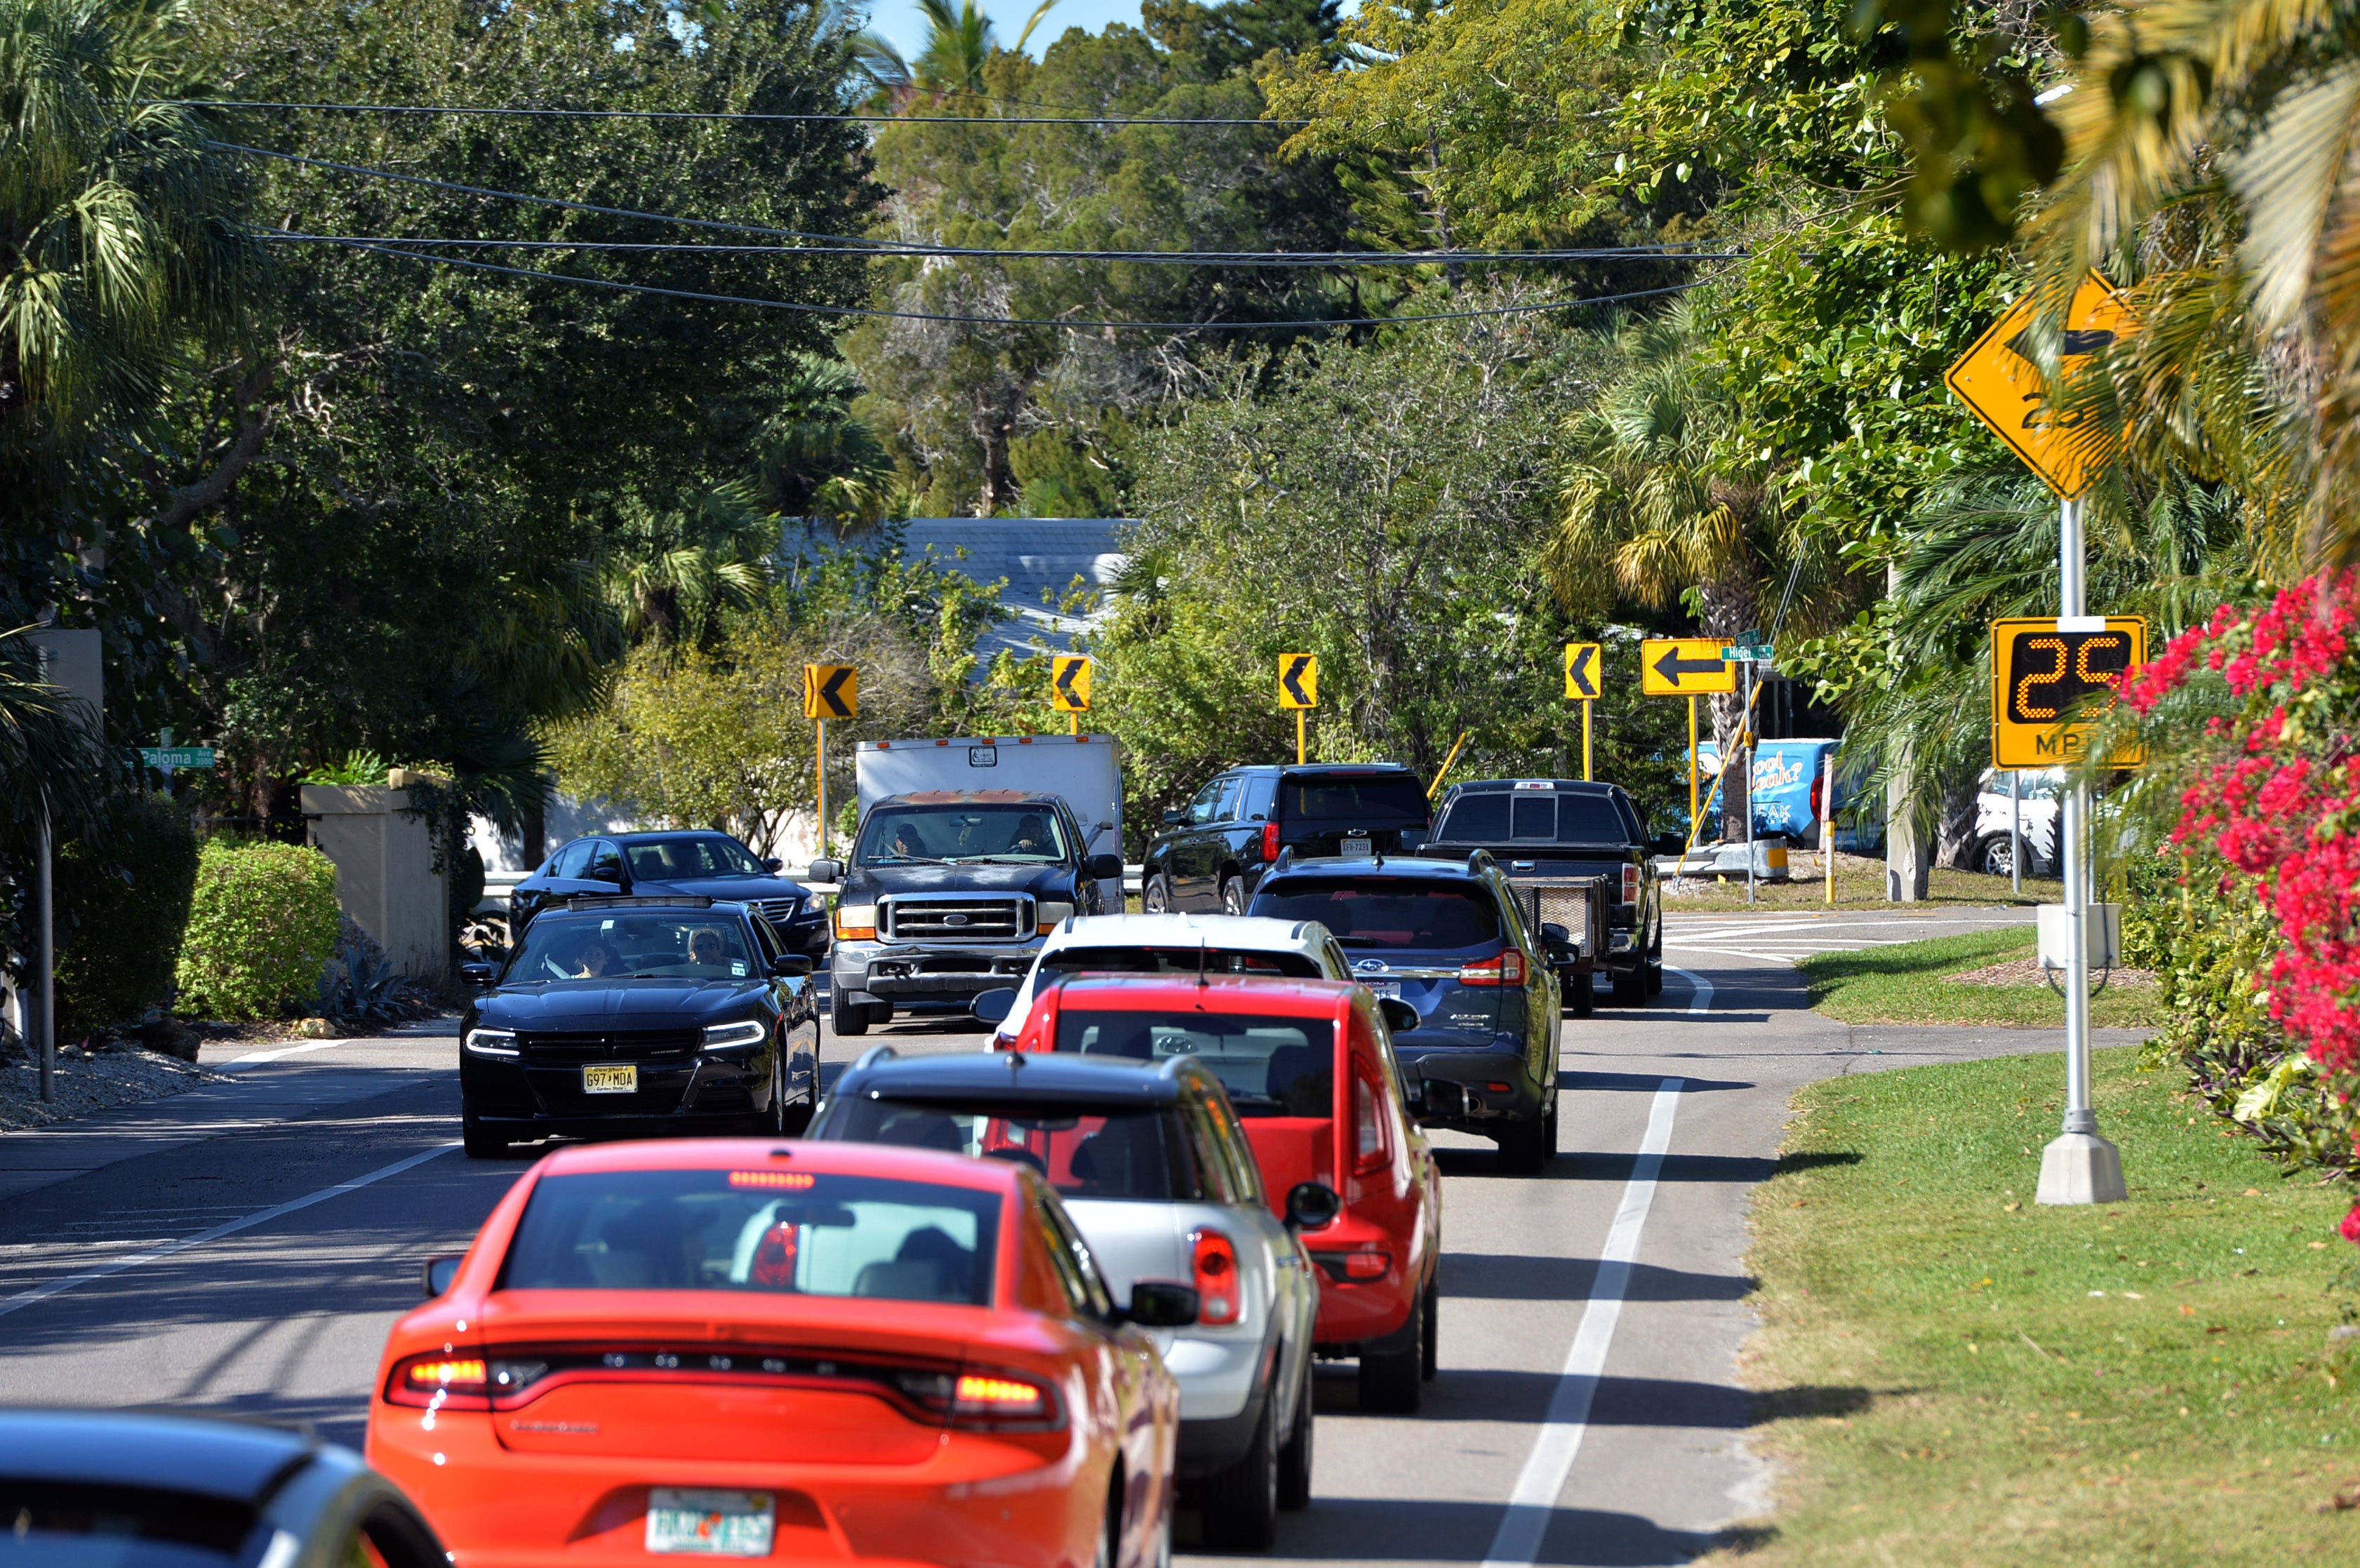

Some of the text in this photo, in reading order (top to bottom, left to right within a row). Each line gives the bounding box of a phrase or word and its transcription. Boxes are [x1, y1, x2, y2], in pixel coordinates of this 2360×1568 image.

[2016, 637, 2121, 719] 25
[2036, 734, 2091, 755] MP
[141, 750, 192, 764] Paloma
[1752, 751, 1784, 775] ool
[587, 1073, 633, 1086] G97 MDA
